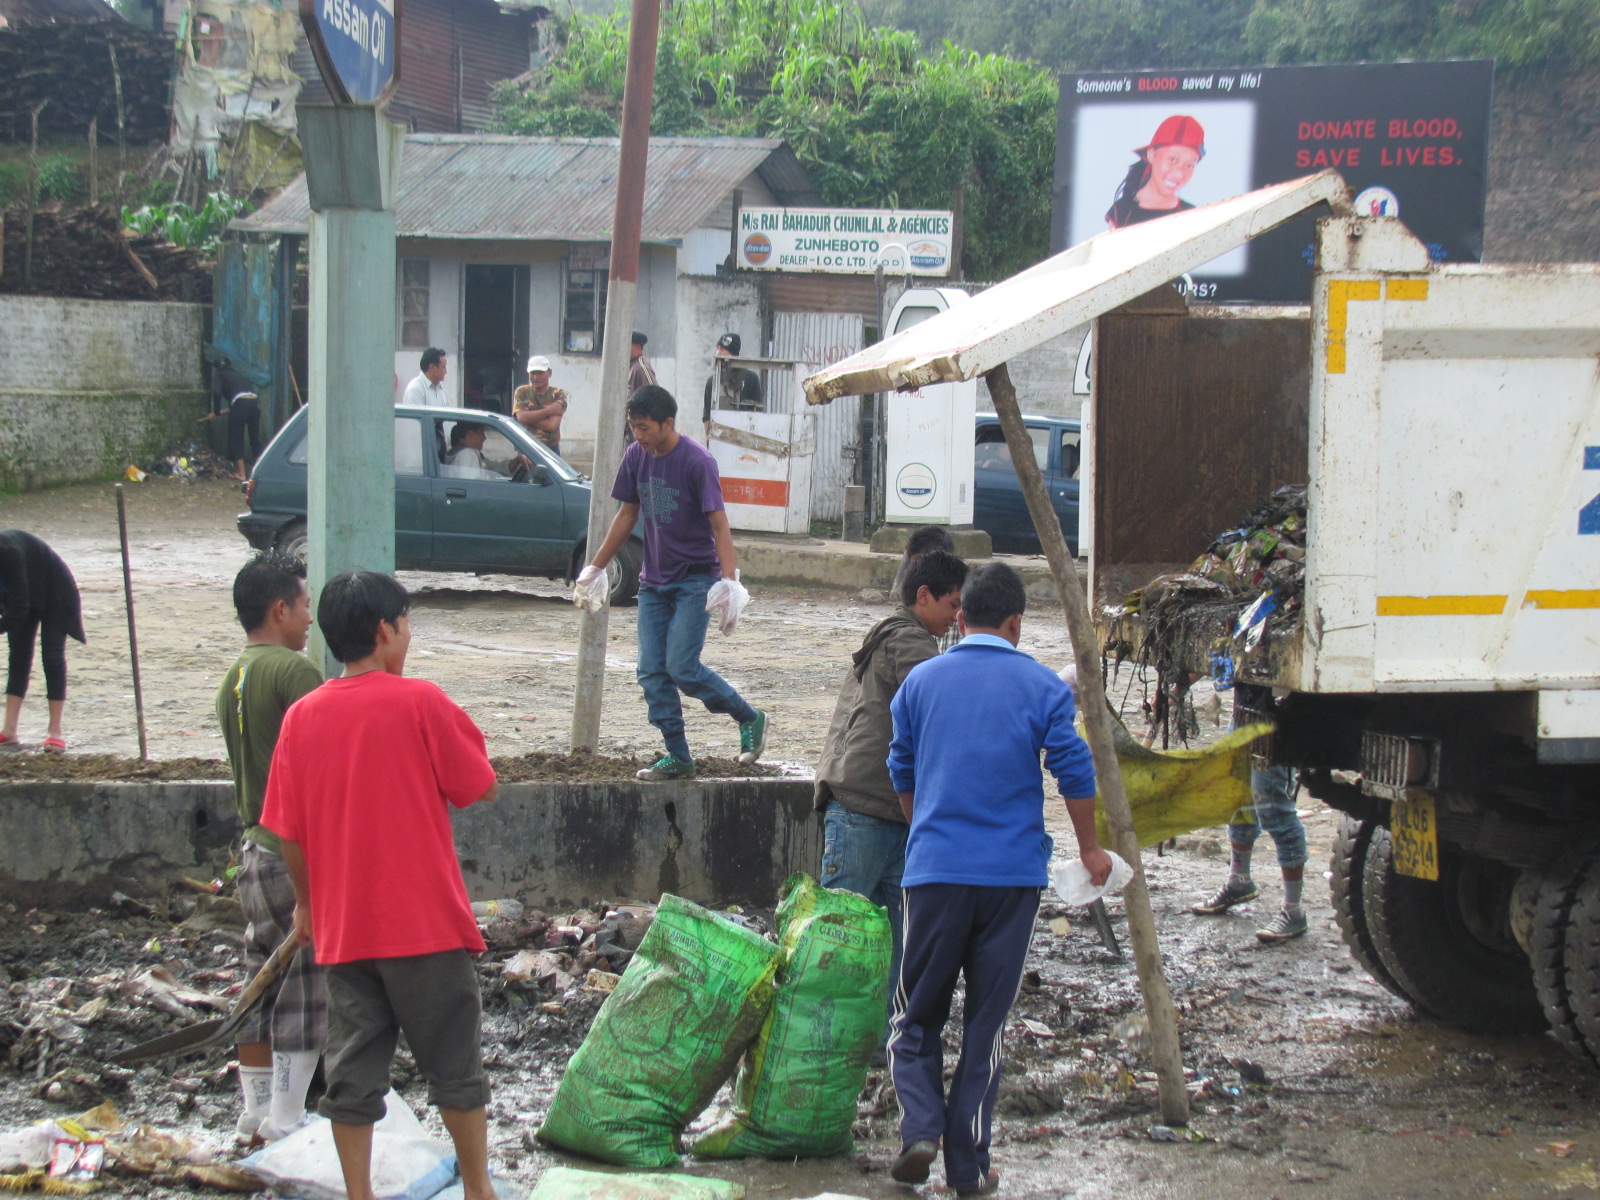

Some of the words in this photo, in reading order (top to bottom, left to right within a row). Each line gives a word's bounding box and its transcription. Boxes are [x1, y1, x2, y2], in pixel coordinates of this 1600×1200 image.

[323, 0, 369, 52] Assam
[371, 9, 386, 66] Oil
[1076, 77, 1131, 94] Someone's
[1138, 77, 1178, 92] BLOOD
[1182, 74, 1214, 90] saved
[1217, 75, 1235, 92] my
[1239, 72, 1262, 88] life!
[1297, 119, 1376, 140] DONATE
[1388, 118, 1463, 140] BLOOD,
[1295, 148, 1361, 167] SAVE
[1380, 146, 1463, 166] LIVES.
[761, 213, 779, 231] RAI
[782, 213, 831, 232] BAHADUR
[833, 215, 885, 233] CHUNILAL
[886, 216, 898, 234] &
[899, 217, 949, 234] AGENCIES
[794, 238, 880, 253] ZUNHEBOTO
[779, 254, 808, 266] DEALER
